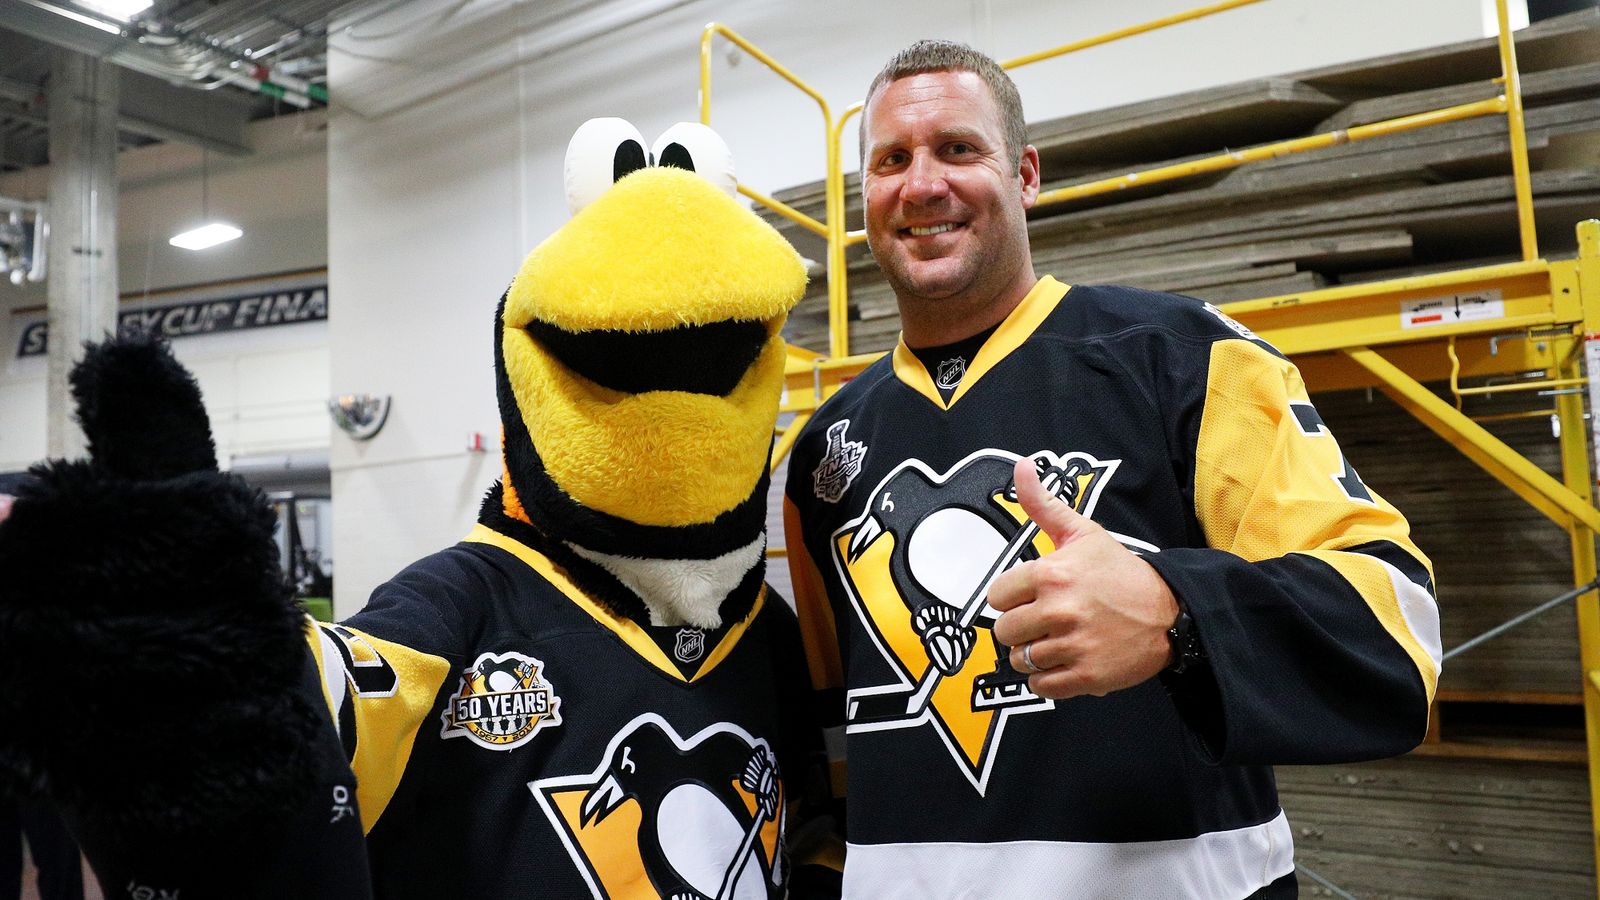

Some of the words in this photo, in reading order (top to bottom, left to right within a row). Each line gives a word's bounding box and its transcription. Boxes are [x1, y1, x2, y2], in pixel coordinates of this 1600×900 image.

[161, 301, 235, 336] CUP
[942, 364, 961, 384] NHL
[816, 447, 861, 485] FINAL
[681, 637, 700, 656] NHL
[457, 697, 481, 720] 50
[487, 692, 546, 716] YEARS
[512, 722, 534, 741] 2017
